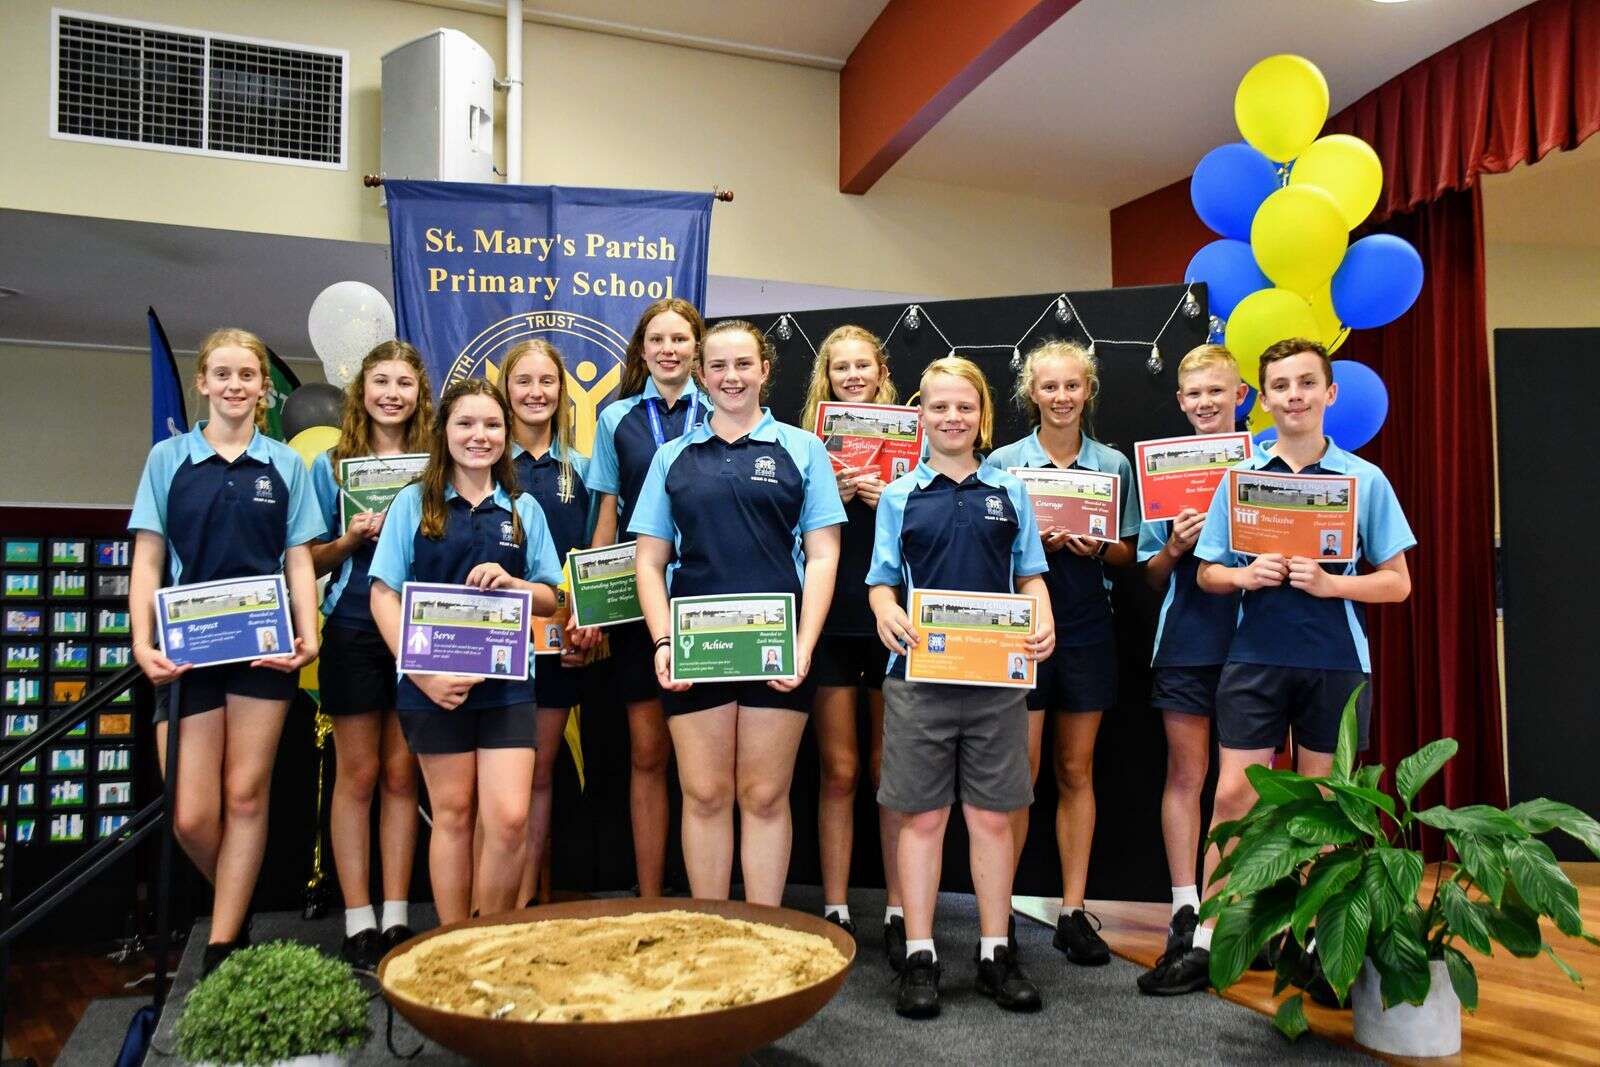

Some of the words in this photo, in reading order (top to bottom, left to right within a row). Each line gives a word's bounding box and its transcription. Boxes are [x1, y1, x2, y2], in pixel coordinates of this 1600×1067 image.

[425, 228, 464, 253] St.
[474, 229, 576, 261] Mary's
[586, 234, 676, 261] Parish
[428, 268, 560, 300] Primary
[573, 272, 672, 299] School
[526, 315, 575, 328] TRUST
[1036, 500, 1064, 510] Courage
[188, 622, 218, 633] Respect
[433, 631, 455, 640] Serve
[702, 640, 733, 650] Achieve
